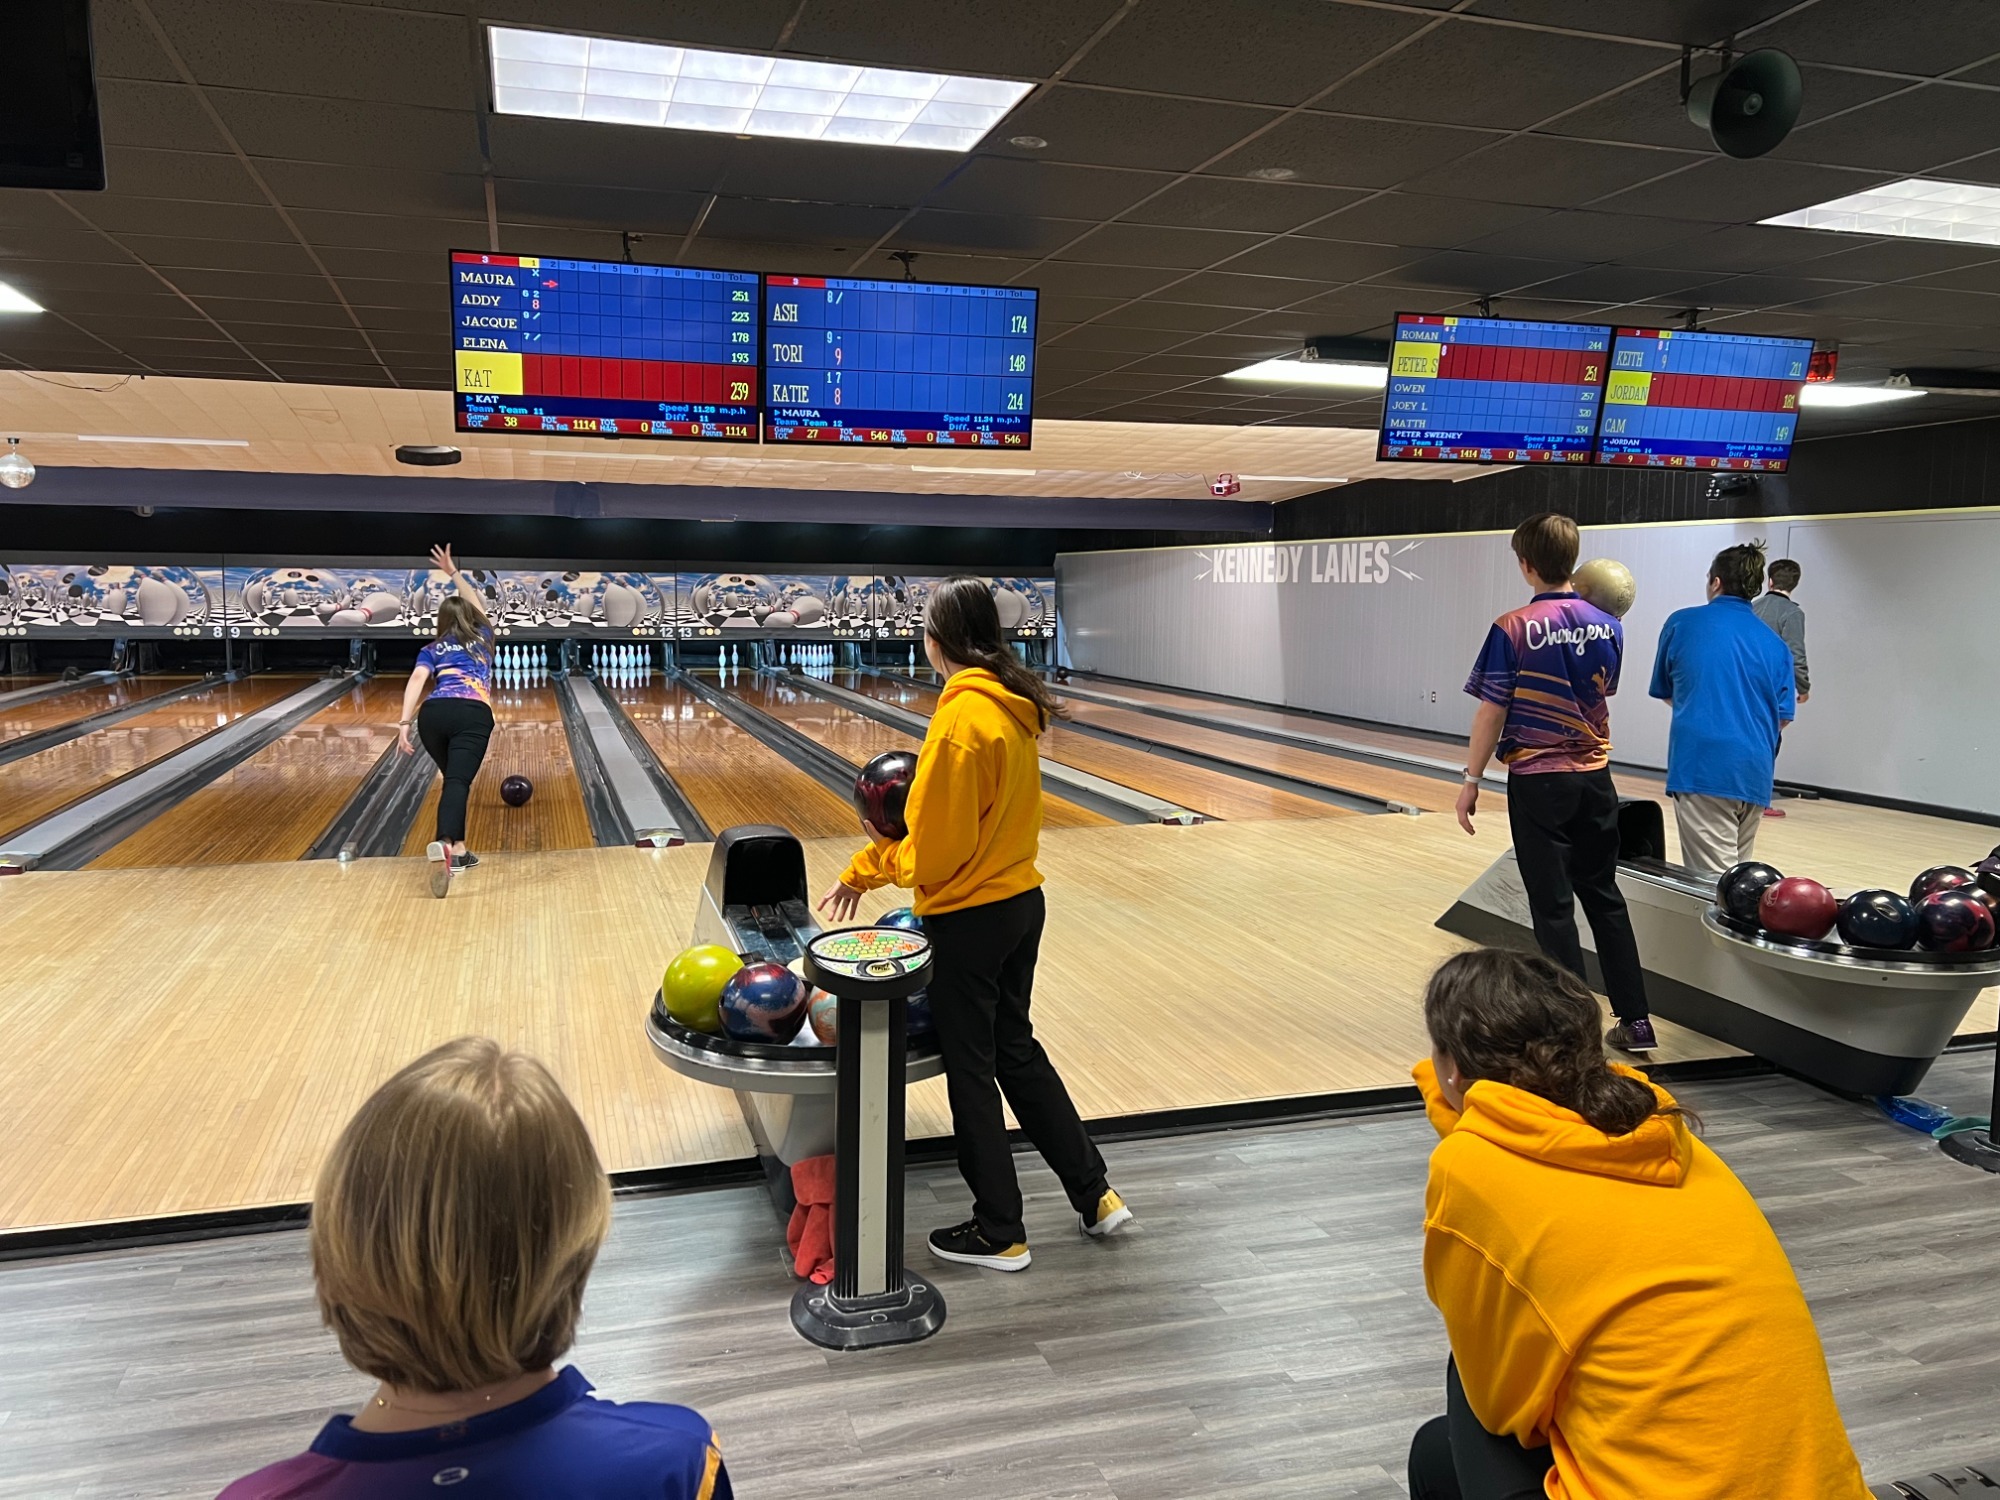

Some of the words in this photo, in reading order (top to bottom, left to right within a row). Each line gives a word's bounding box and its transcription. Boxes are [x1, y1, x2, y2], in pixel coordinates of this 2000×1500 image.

[482, 255, 489, 264] 3
[460, 272, 515, 286] MAURA
[461, 294, 501, 306] ADDY
[533, 290, 539, 298] 2
[732, 290, 750, 302] 251
[532, 299, 540, 309] 8
[773, 303, 798, 322] ASH
[827, 290, 833, 303] 8
[731, 311, 750, 322] 223
[461, 316, 517, 329] JACQUE
[1011, 315, 1027, 333] 174
[463, 337, 508, 349] ELENA
[523, 332, 530, 340] 7
[732, 332, 749, 343] 178
[1401, 330, 1439, 341] ROMAN
[773, 344, 803, 362] TORI
[827, 331, 833, 343] 9
[1588, 341, 1602, 350] 244
[732, 352, 749, 363] 193
[835, 348, 842, 365] 9
[1616, 350, 1644, 367] KEITH
[1662, 354, 1668, 369] 9
[1009, 355, 1025, 372] 148
[1397, 356, 1428, 373] PETER
[1431, 358, 1439, 373] S
[464, 369, 492, 387] KAT
[1584, 365, 1598, 381] 251
[730, 382, 749, 400] 239
[773, 384, 809, 403] KATIE
[827, 372, 832, 383] 1
[836, 372, 841, 383] 7
[1394, 383, 1426, 393] OWEN
[1610, 385, 1648, 401] JORDAN
[475, 395, 499, 403] KAT
[834, 388, 841, 405] 8
[1007, 393, 1024, 410] 214
[467, 404, 494, 413] Team
[499, 406, 528, 414] Team
[659, 403, 689, 413] Speed
[720, 407, 746, 415] m.p.h
[1392, 401, 1418, 411] JOEY
[1421, 402, 1428, 411] L
[665, 413, 689, 421] Diff.
[782, 409, 820, 418] MAURA
[943, 414, 970, 423] Speed
[504, 416, 518, 427] 38
[573, 420, 596, 430] 1114
[641, 422, 648, 432] 0
[774, 418, 798, 426] Team
[802, 419, 828, 427] Team
[949, 423, 970, 431] Diff.
[1390, 419, 1426, 428] MATTH
[1605, 418, 1626, 434] CAM
[691, 425, 699, 434] 0
[726, 426, 747, 436] 1114
[806, 429, 818, 439] 27
[1424, 431, 1463, 439] SWEENEY
[1775, 427, 1789, 441] 149
[870, 431, 888, 441] 546
[926, 432, 933, 442] 0
[971, 434, 978, 443] 0
[1004, 434, 1021, 444] 546
[1413, 448, 1423, 457] 14
[1460, 449, 1477, 458] 1414
[1508, 450, 1514, 459] 0
[1544, 452, 1550, 460] 0
[1567, 453, 1584, 461] 1414
[1628, 455, 1633, 463] 9
[1212, 546, 1304, 583] KENNEDY
[1311, 541, 1390, 584] LANES
[213, 626, 223, 638] 8
[230, 626, 240, 638] 9
[660, 627, 674, 638] 12
[678, 627, 692, 638] 13
[858, 628, 871, 639] 14
[876, 627, 890, 638] 15
[1041, 628, 1054, 638] 16
